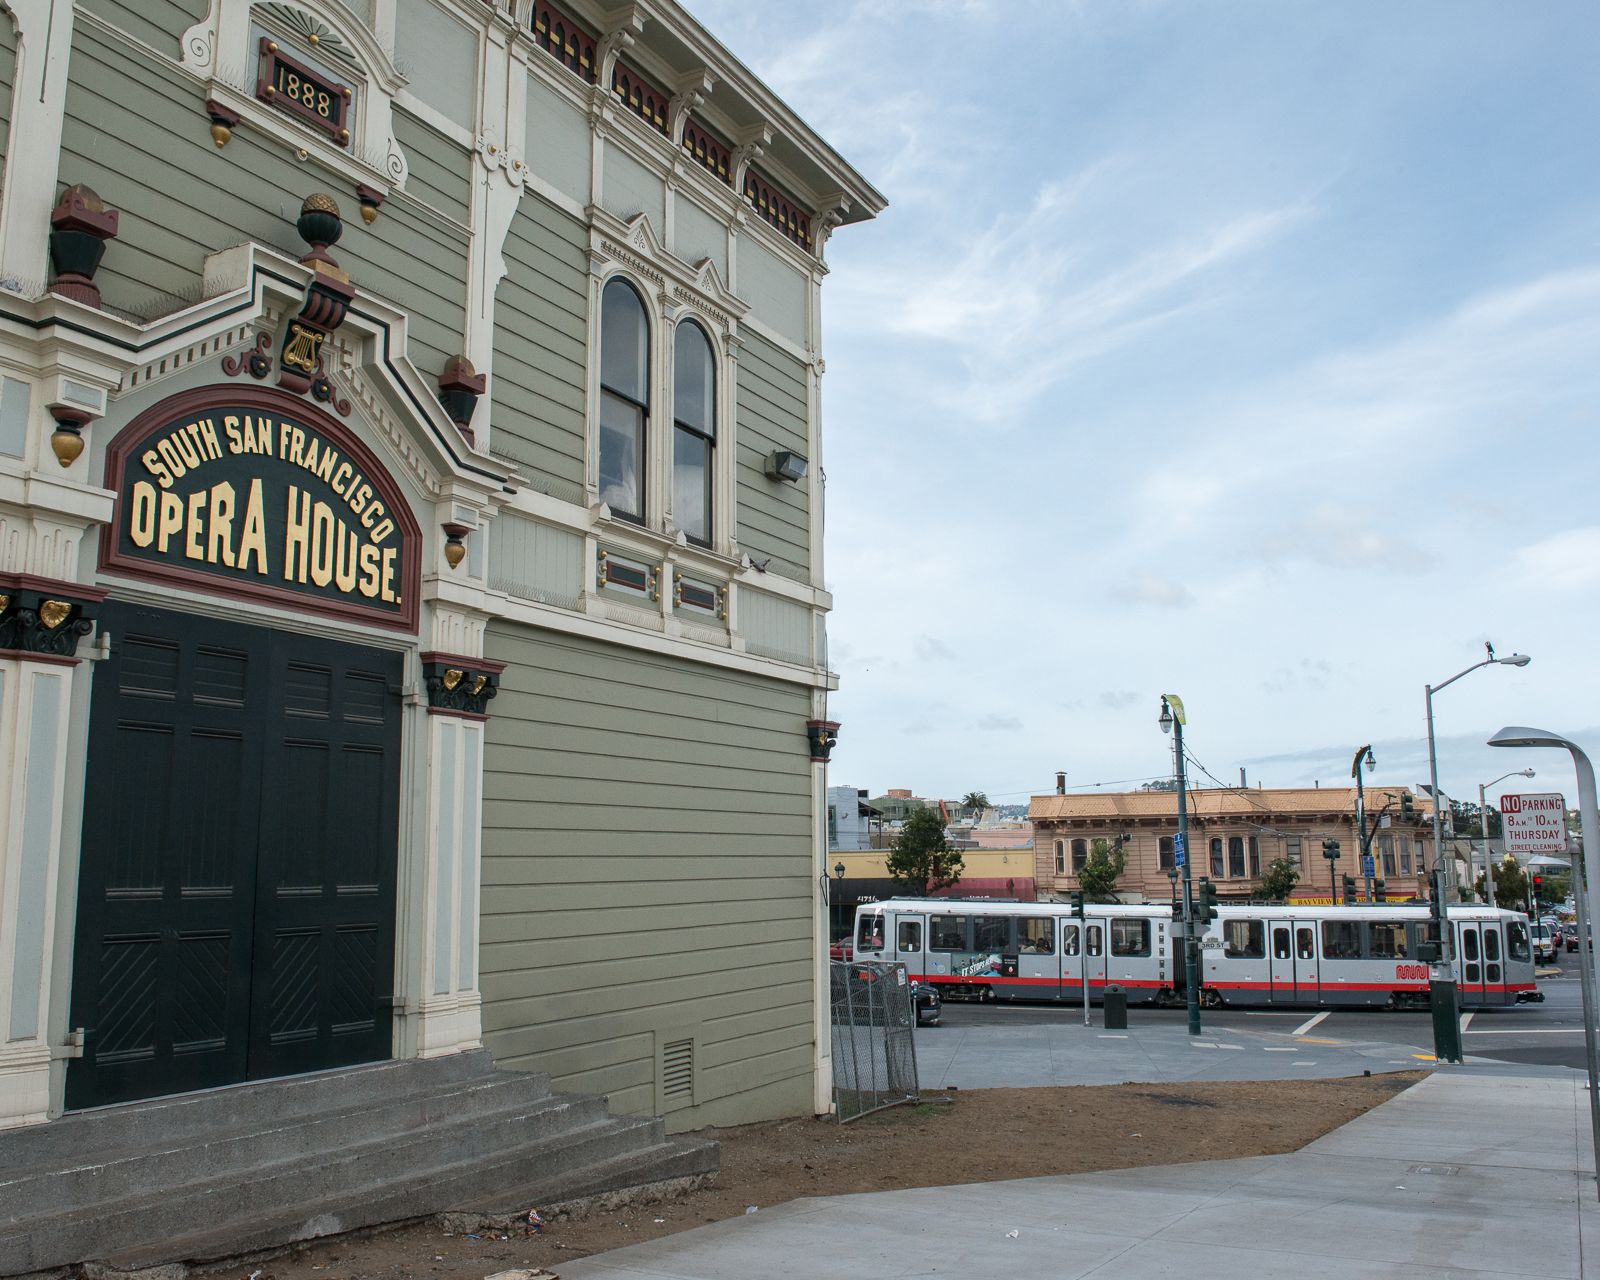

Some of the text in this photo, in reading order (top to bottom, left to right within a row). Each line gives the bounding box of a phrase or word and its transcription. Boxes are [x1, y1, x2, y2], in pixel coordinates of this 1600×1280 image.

[279, 66, 330, 118] 1888
[142, 415, 395, 544] SOUTH SAN FRANCISCO
[130, 478, 269, 576] OPERA
[1503, 796, 1561, 811] NO PARKING
[1508, 815, 1514, 826] 8
[1535, 815, 1545, 826] 10
[1508, 830, 1560, 839] THURSDAY
[1532, 843, 1562, 851] CLEANING
